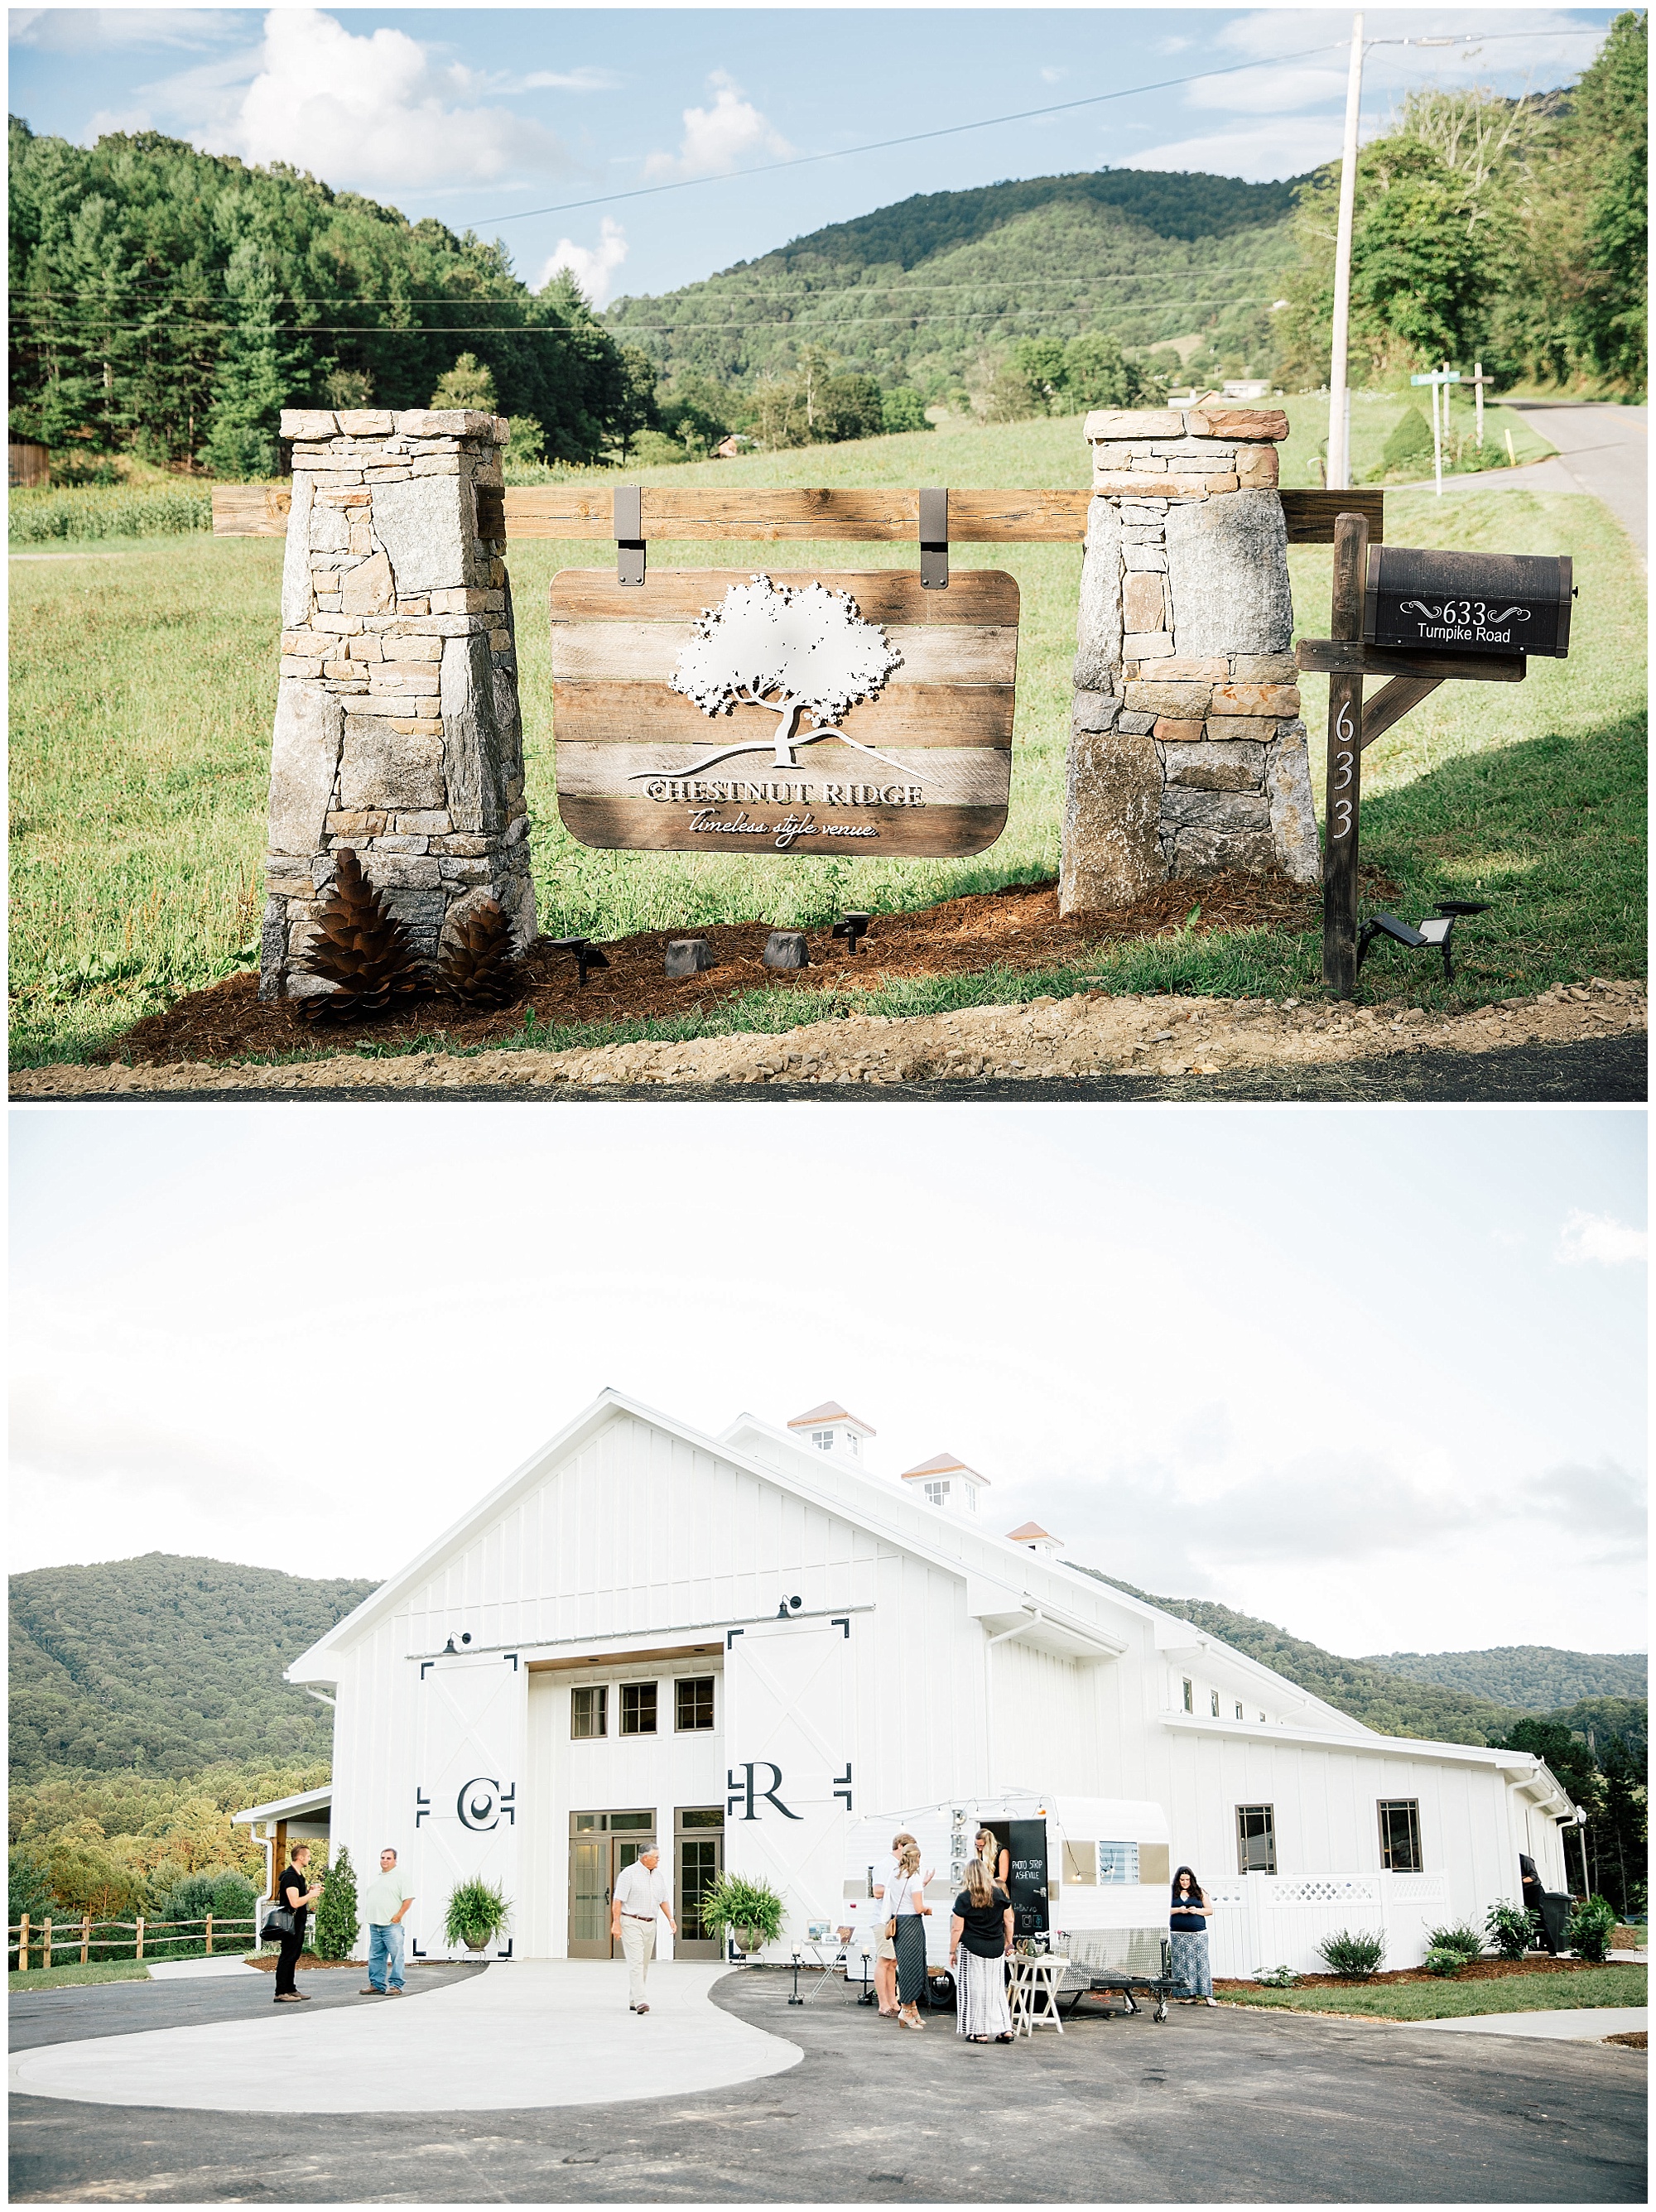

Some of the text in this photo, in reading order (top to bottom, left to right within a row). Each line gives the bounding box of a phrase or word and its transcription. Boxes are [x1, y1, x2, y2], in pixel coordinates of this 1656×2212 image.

[1443, 601, 1486, 626] 633
[1417, 623, 1510, 643] Turnpike Road
[1333, 700, 1355, 839] 633
[643, 778, 925, 808] CHESTNUT RIDGE
[687, 808, 768, 835] Timeless
[772, 812, 817, 849] style
[1012, 1859, 1042, 1869] PHOTO STRIP
